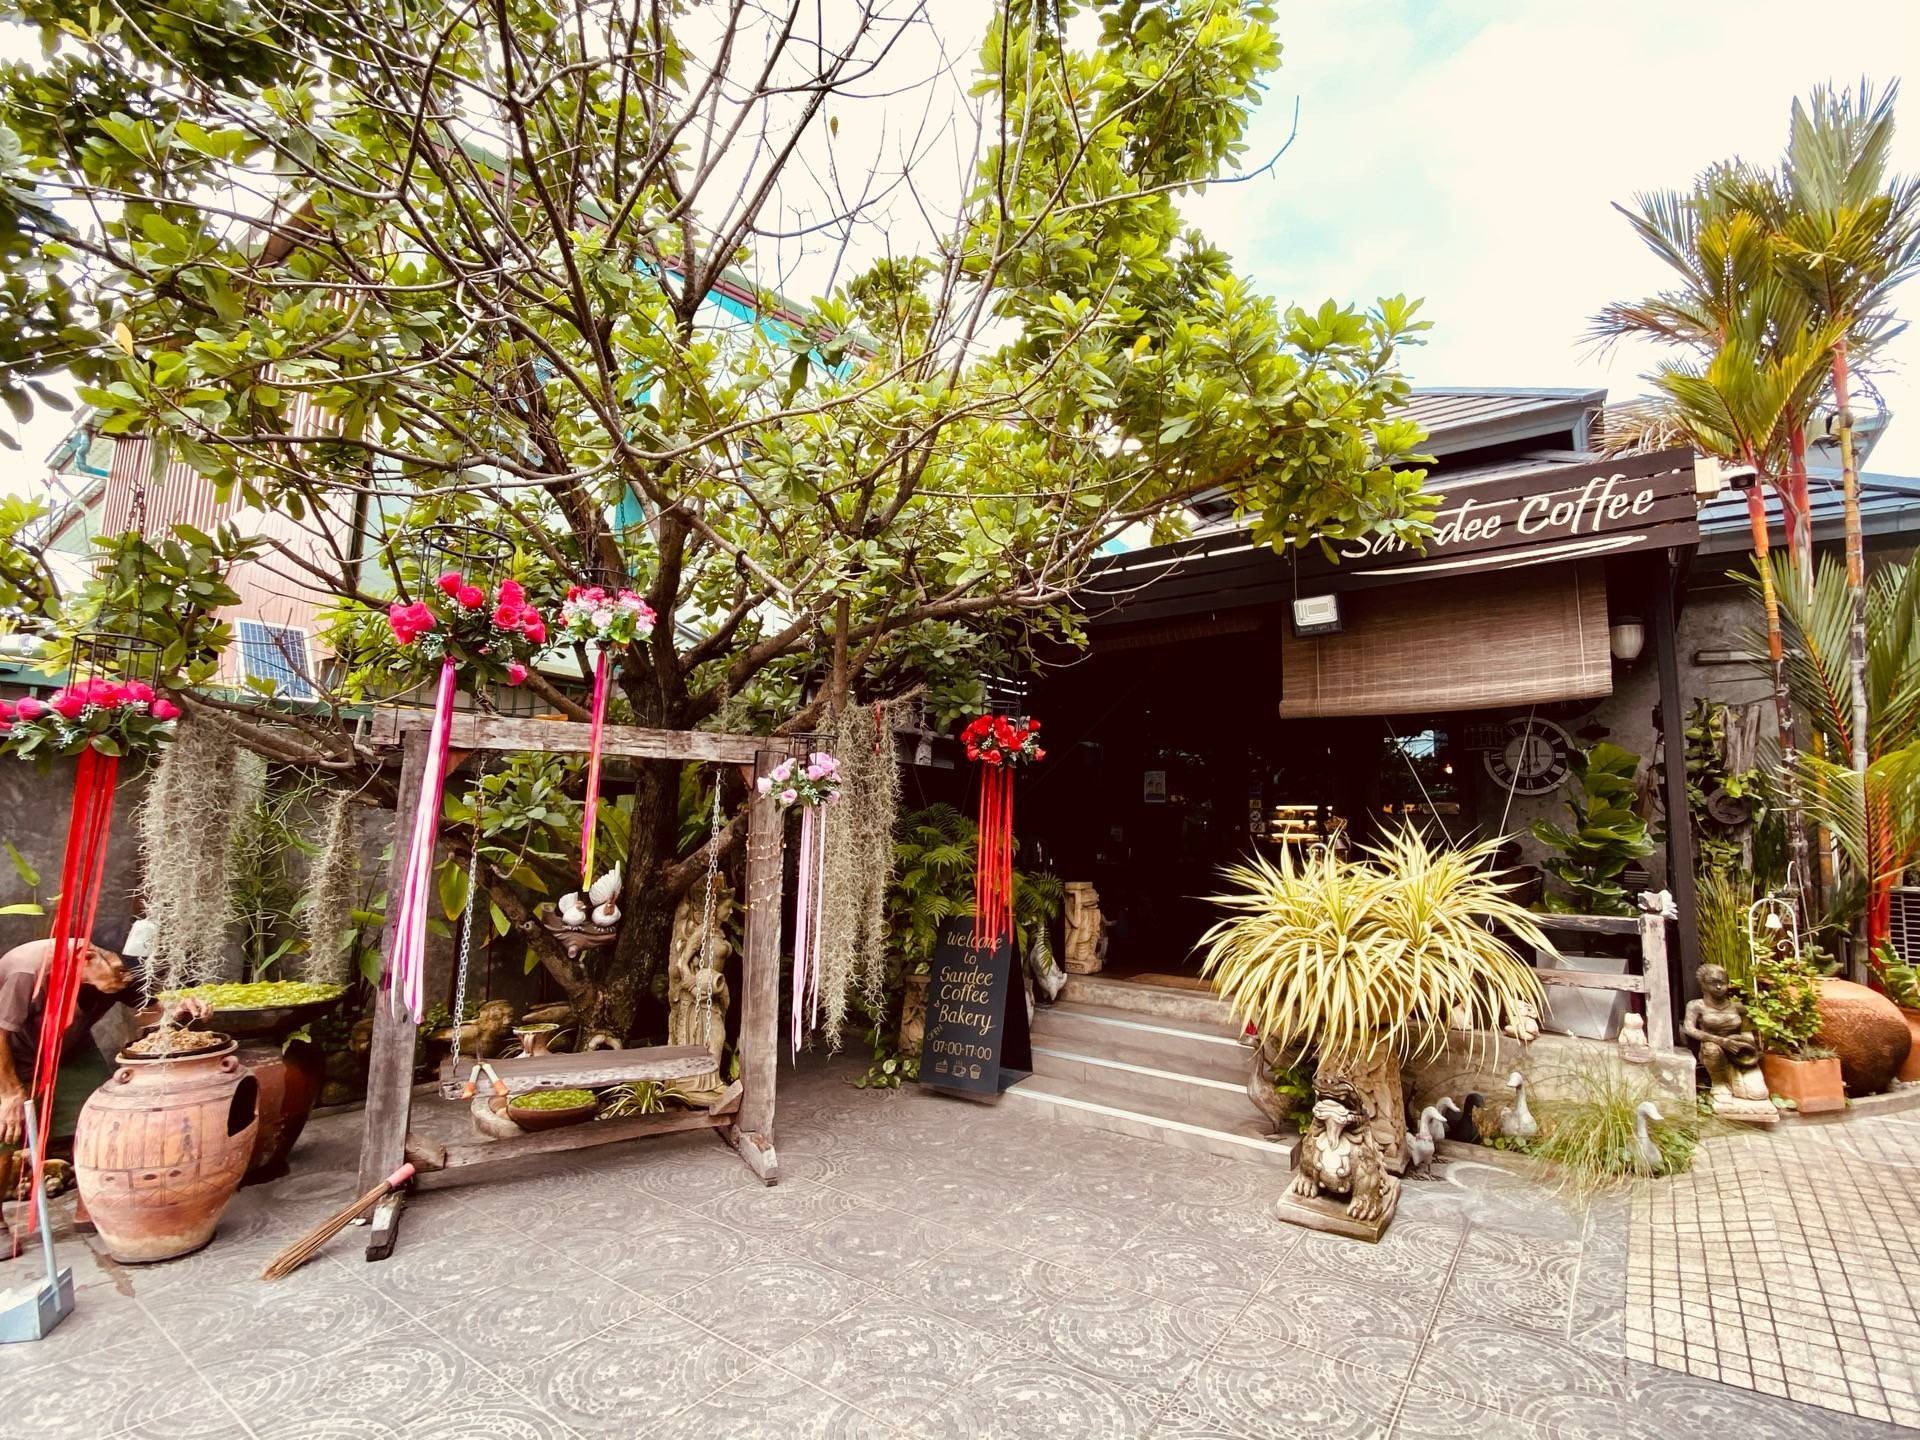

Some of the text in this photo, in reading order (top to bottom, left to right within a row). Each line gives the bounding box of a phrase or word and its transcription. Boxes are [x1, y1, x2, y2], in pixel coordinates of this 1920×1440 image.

[1517, 473, 1655, 535] Coffee
[964, 951, 976, 965] to
[940, 965, 993, 986] Sandee
[941, 984, 989, 1004] Coffee
[939, 1004, 995, 1035] Bakery
